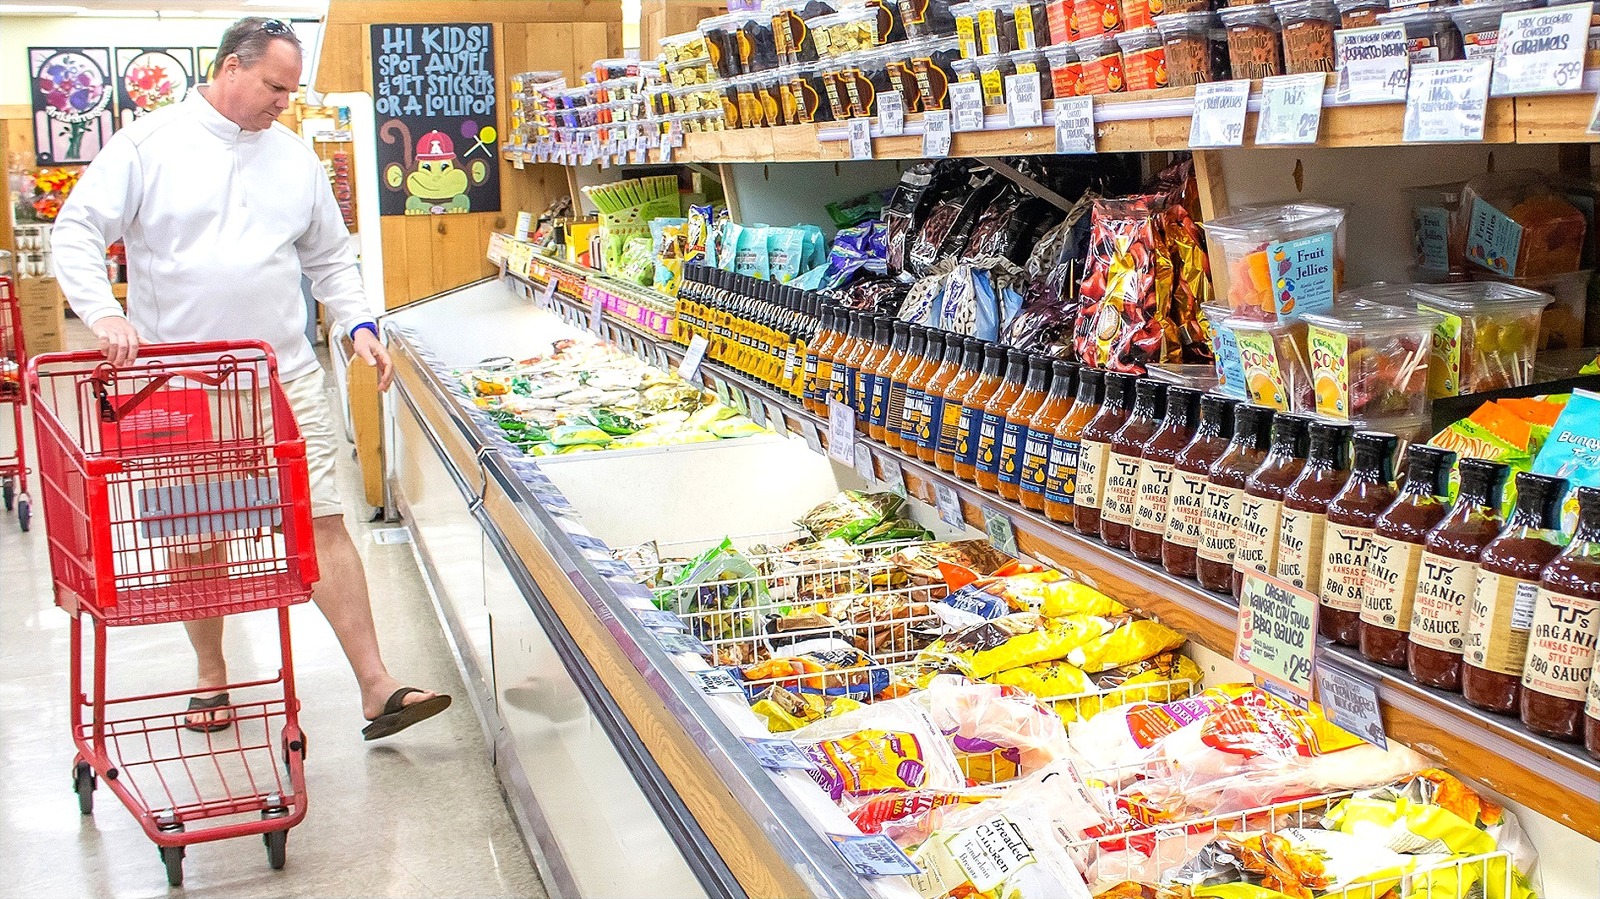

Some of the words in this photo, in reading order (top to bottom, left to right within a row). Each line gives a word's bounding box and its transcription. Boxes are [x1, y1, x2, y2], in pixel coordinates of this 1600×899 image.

[382, 27, 413, 54] HI
[422, 26, 489, 53] KIDS!
[378, 53, 422, 76] SPOT
[425, 51, 489, 76] ANGEL
[392, 75, 424, 96] GET
[428, 74, 495, 96] STICKERS
[376, 97, 402, 116] OR
[404, 96, 422, 116] A
[426, 94, 496, 116] LOLLIPOP
[1297, 248, 1324, 263] Fruit
[1296, 264, 1328, 280] Jellies
[1109, 476, 1137, 488] ORGA
[1142, 484, 1168, 496] ORGA
[1152, 503, 1166, 512] STYL
[1174, 496, 1202, 508] ORGA
[1241, 518, 1268, 538] ANIC
[1206, 537, 1236, 550] SAUCE
[1369, 562, 1398, 584] ANIC
[1425, 563, 1460, 585] TJ's
[1327, 579, 1344, 596] BBQ
[1420, 582, 1466, 606] RGANIC
[1547, 598, 1598, 629] TJ's
[1422, 618, 1460, 634] SAUCE
[1540, 640, 1568, 653] KANSAS
[1571, 646, 1590, 658] CITY
[1548, 652, 1573, 666] STYLE
[1530, 654, 1548, 676] BBQ
[976, 824, 1008, 873] Chicken
[992, 819, 1030, 862] Breaded
